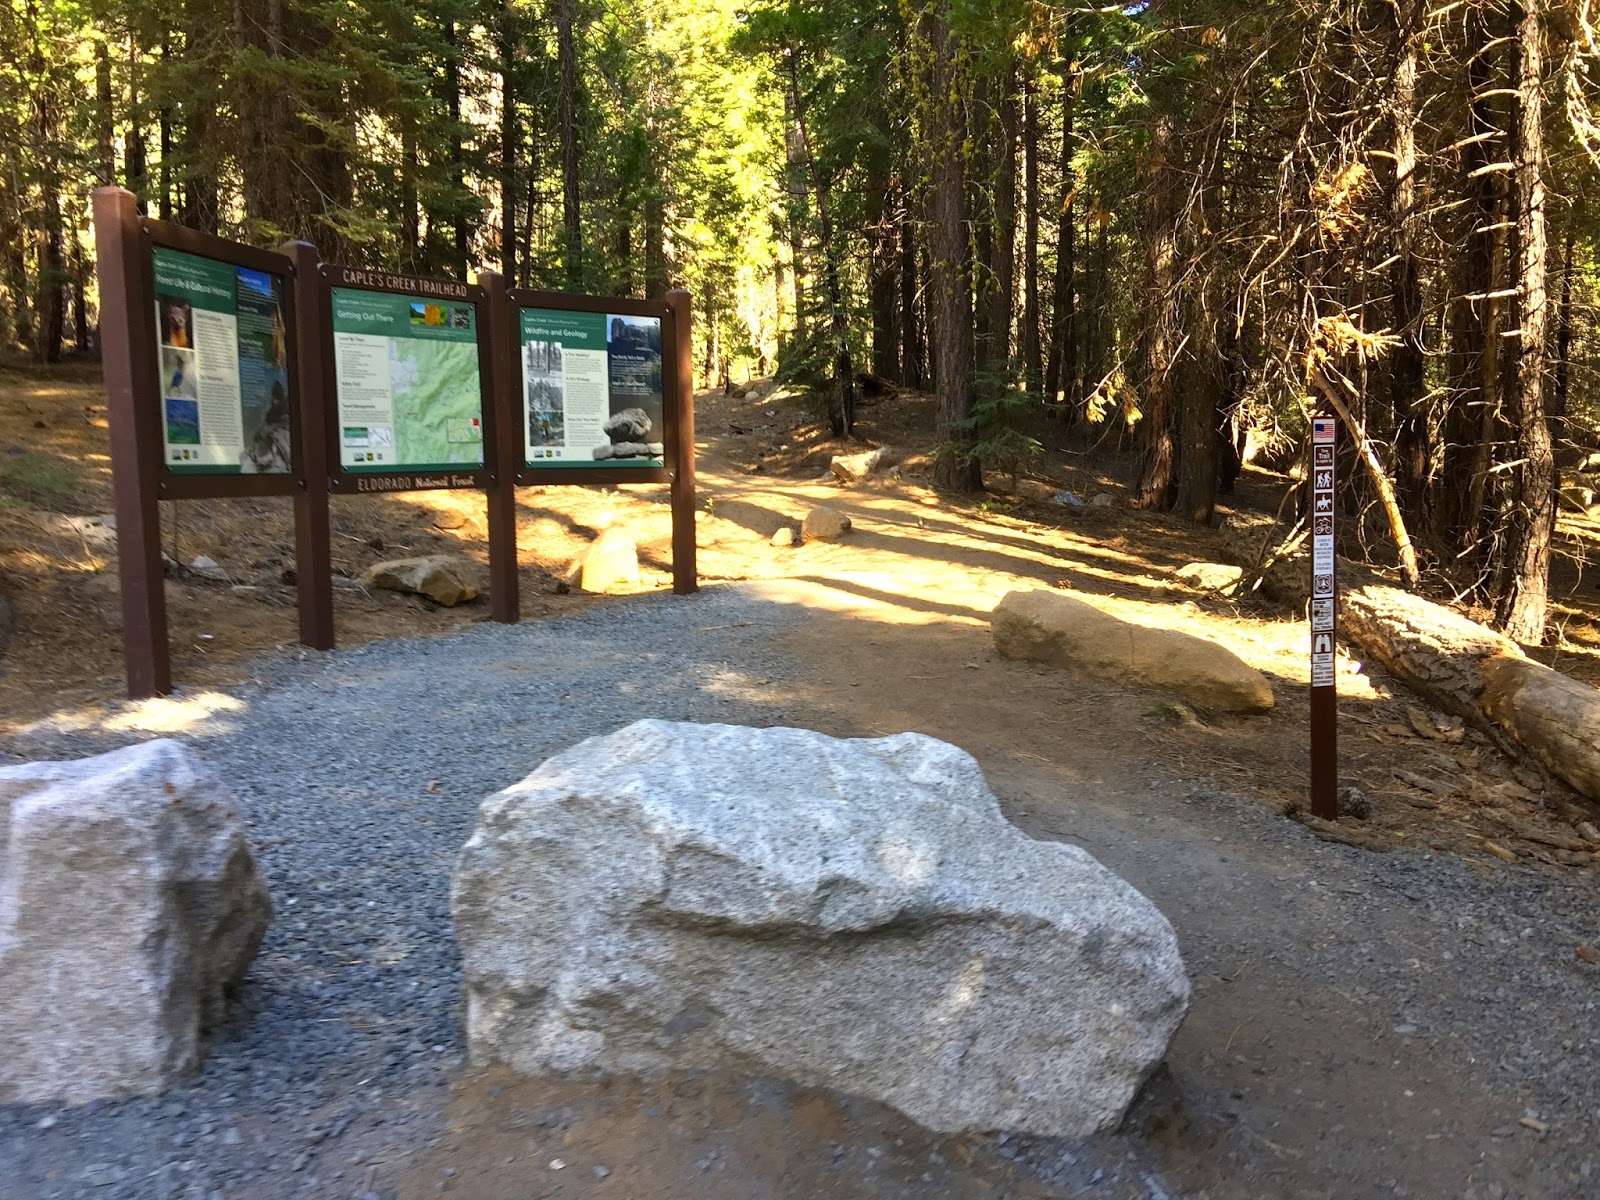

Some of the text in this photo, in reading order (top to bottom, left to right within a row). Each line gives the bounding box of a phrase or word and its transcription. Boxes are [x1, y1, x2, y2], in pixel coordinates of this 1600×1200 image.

[342, 269, 467, 297] CAPLE'S CREEK TRAILHEAD
[336, 309, 395, 323] Getting Out There
[524, 327, 550, 336] Wildfire
[563, 329, 588, 340] Geology
[357, 474, 475, 491] ELDORADO National Forest
